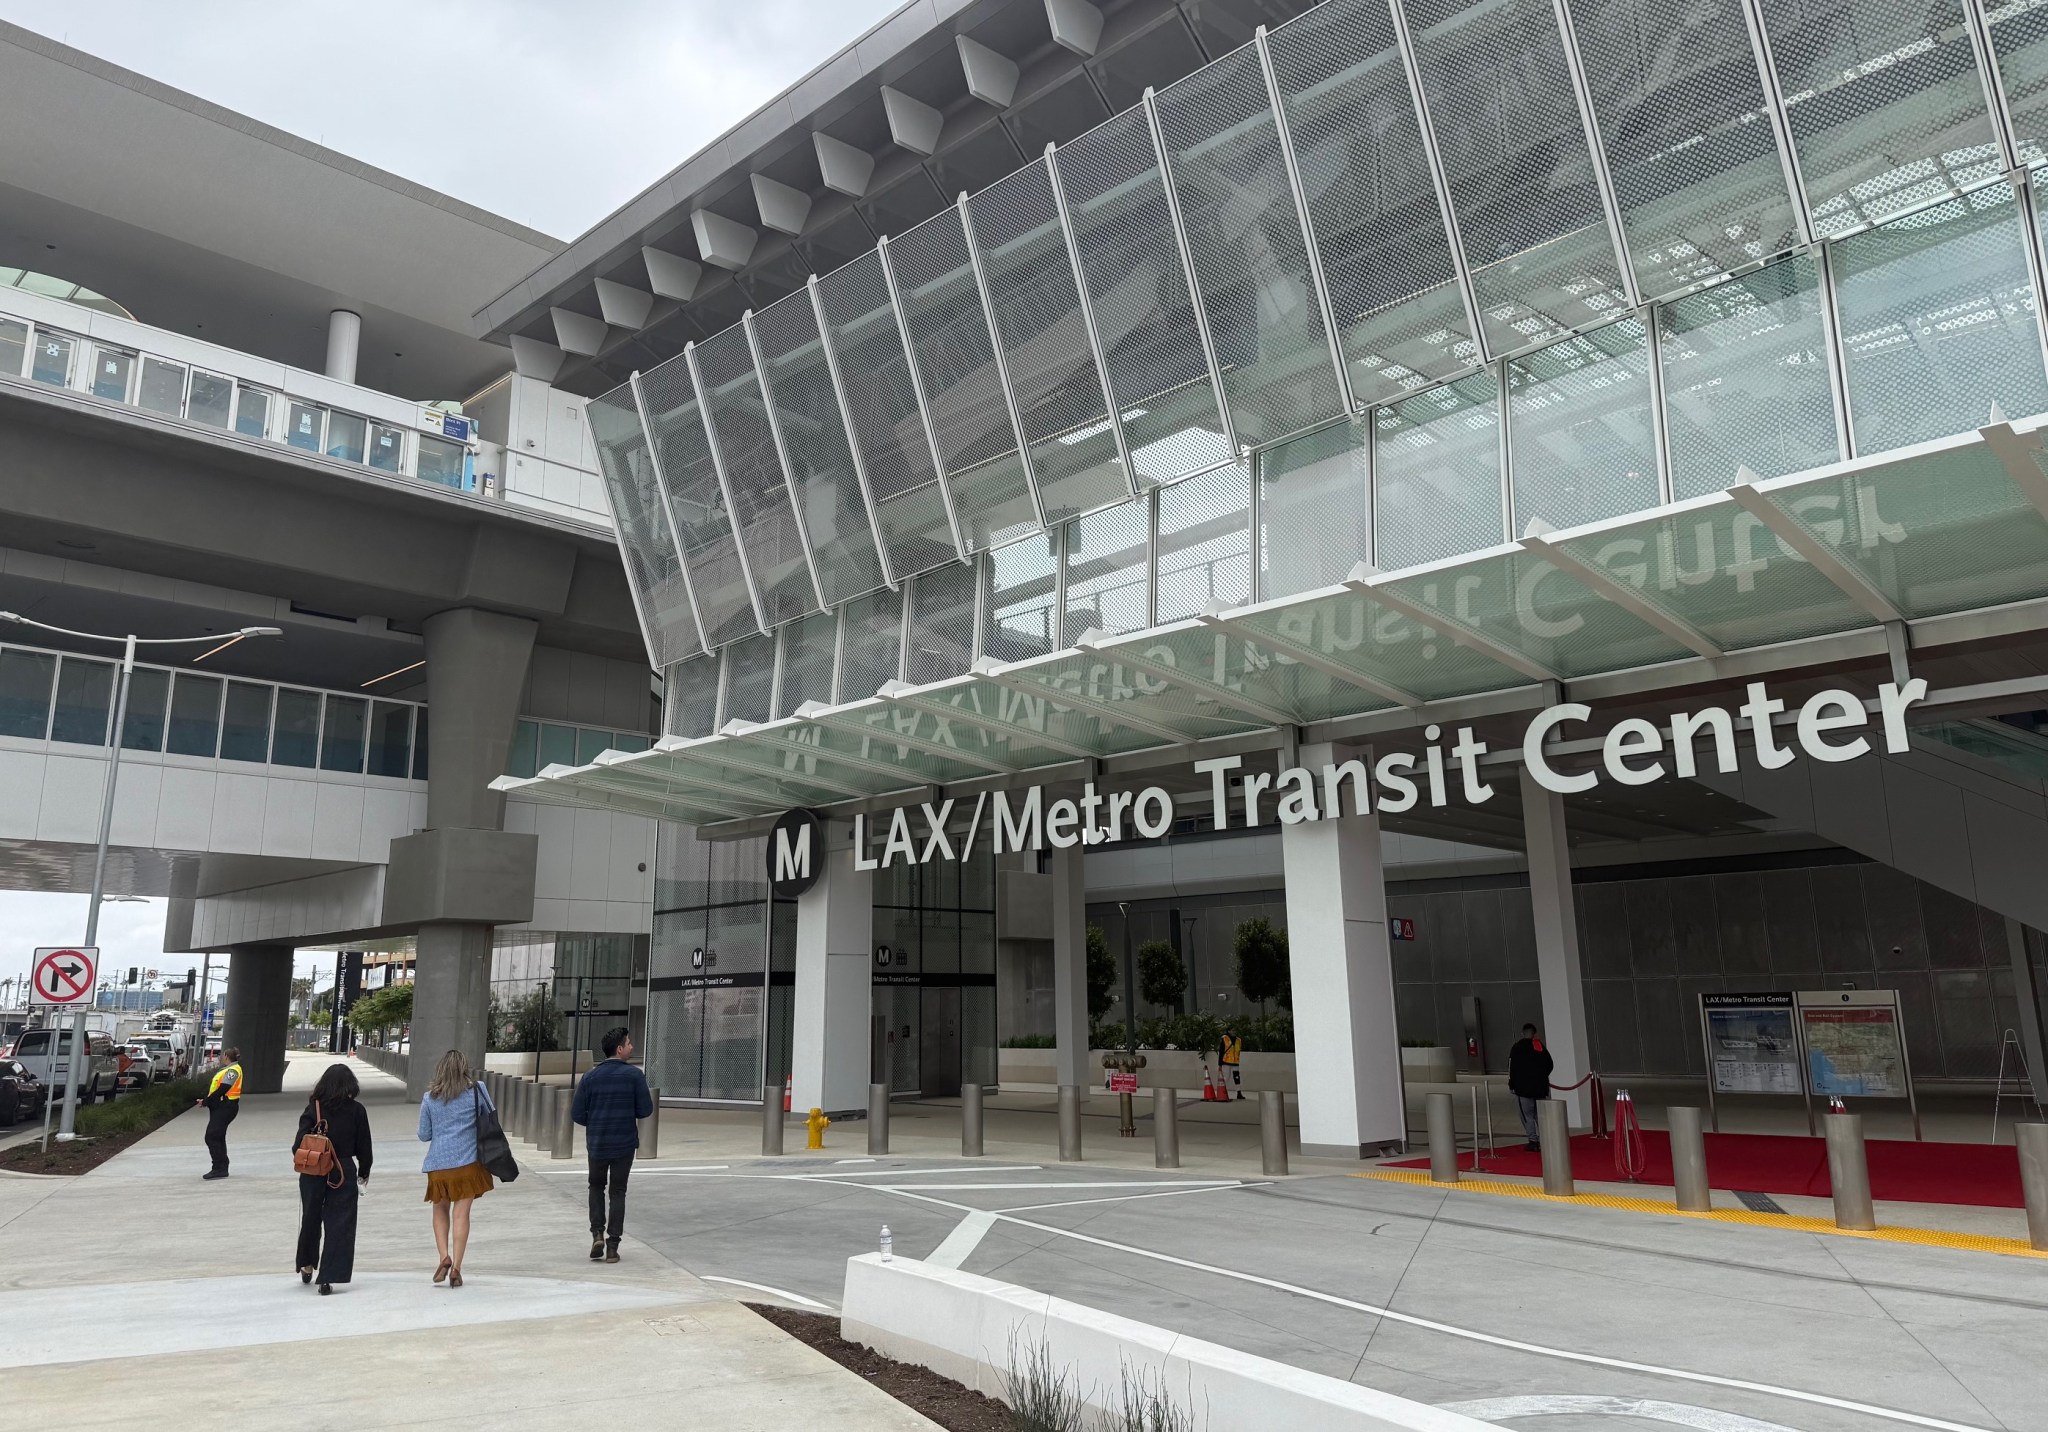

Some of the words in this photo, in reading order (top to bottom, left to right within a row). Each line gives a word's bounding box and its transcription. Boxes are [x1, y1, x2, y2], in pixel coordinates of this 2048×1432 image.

[854, 782, 1174, 873] LAX/Metro
[1194, 724, 1496, 830] Transit
[1522, 676, 1930, 794] Center
[775, 823, 812, 882] M
[693, 952, 702, 966] M
[878, 948, 890, 963] M
[1705, 996, 1742, 1004] LAX/Metro
[1766, 995, 1790, 1003] Center
